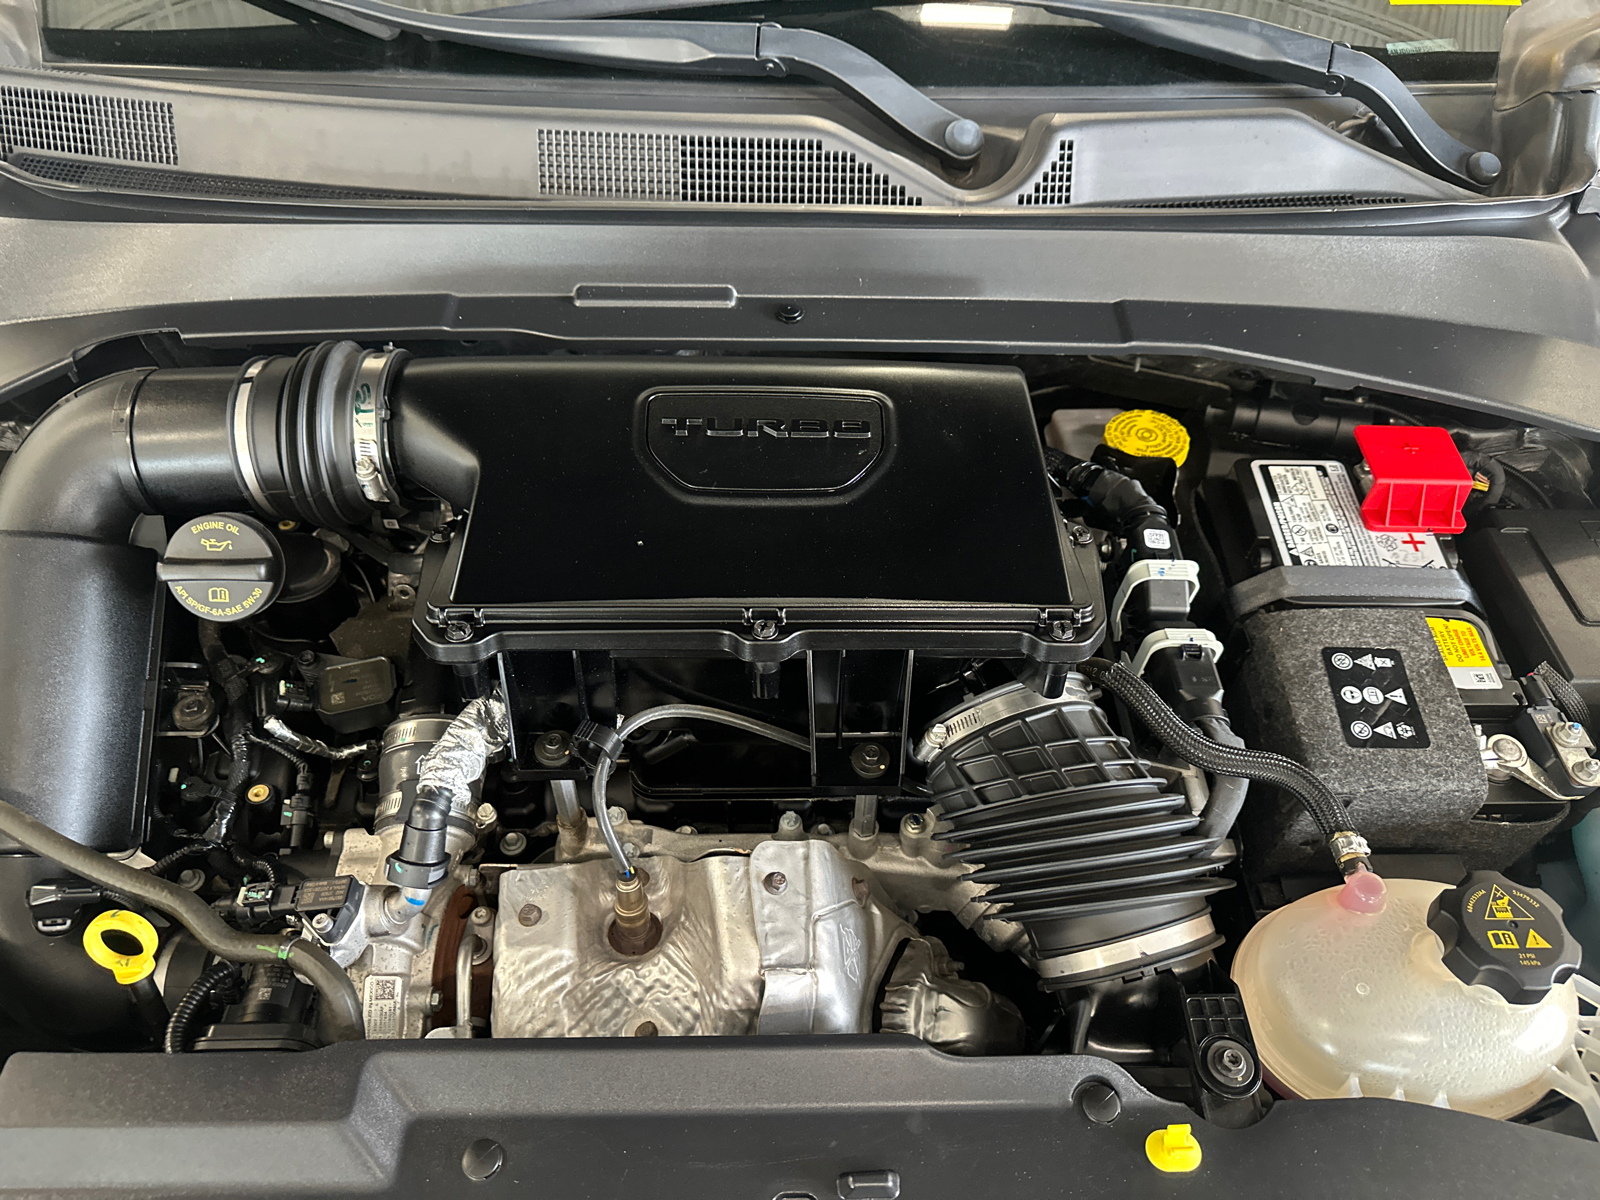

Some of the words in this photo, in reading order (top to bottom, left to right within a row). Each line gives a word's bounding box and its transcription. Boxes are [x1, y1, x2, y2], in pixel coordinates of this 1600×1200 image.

[191, 521, 224, 534] ENGINE
[226, 523, 240, 535] OIL
[175, 585, 188, 599] API
[186, 597, 243, 616] SP/GF-6A-SAE
[242, 587, 262, 608] 5W-30
